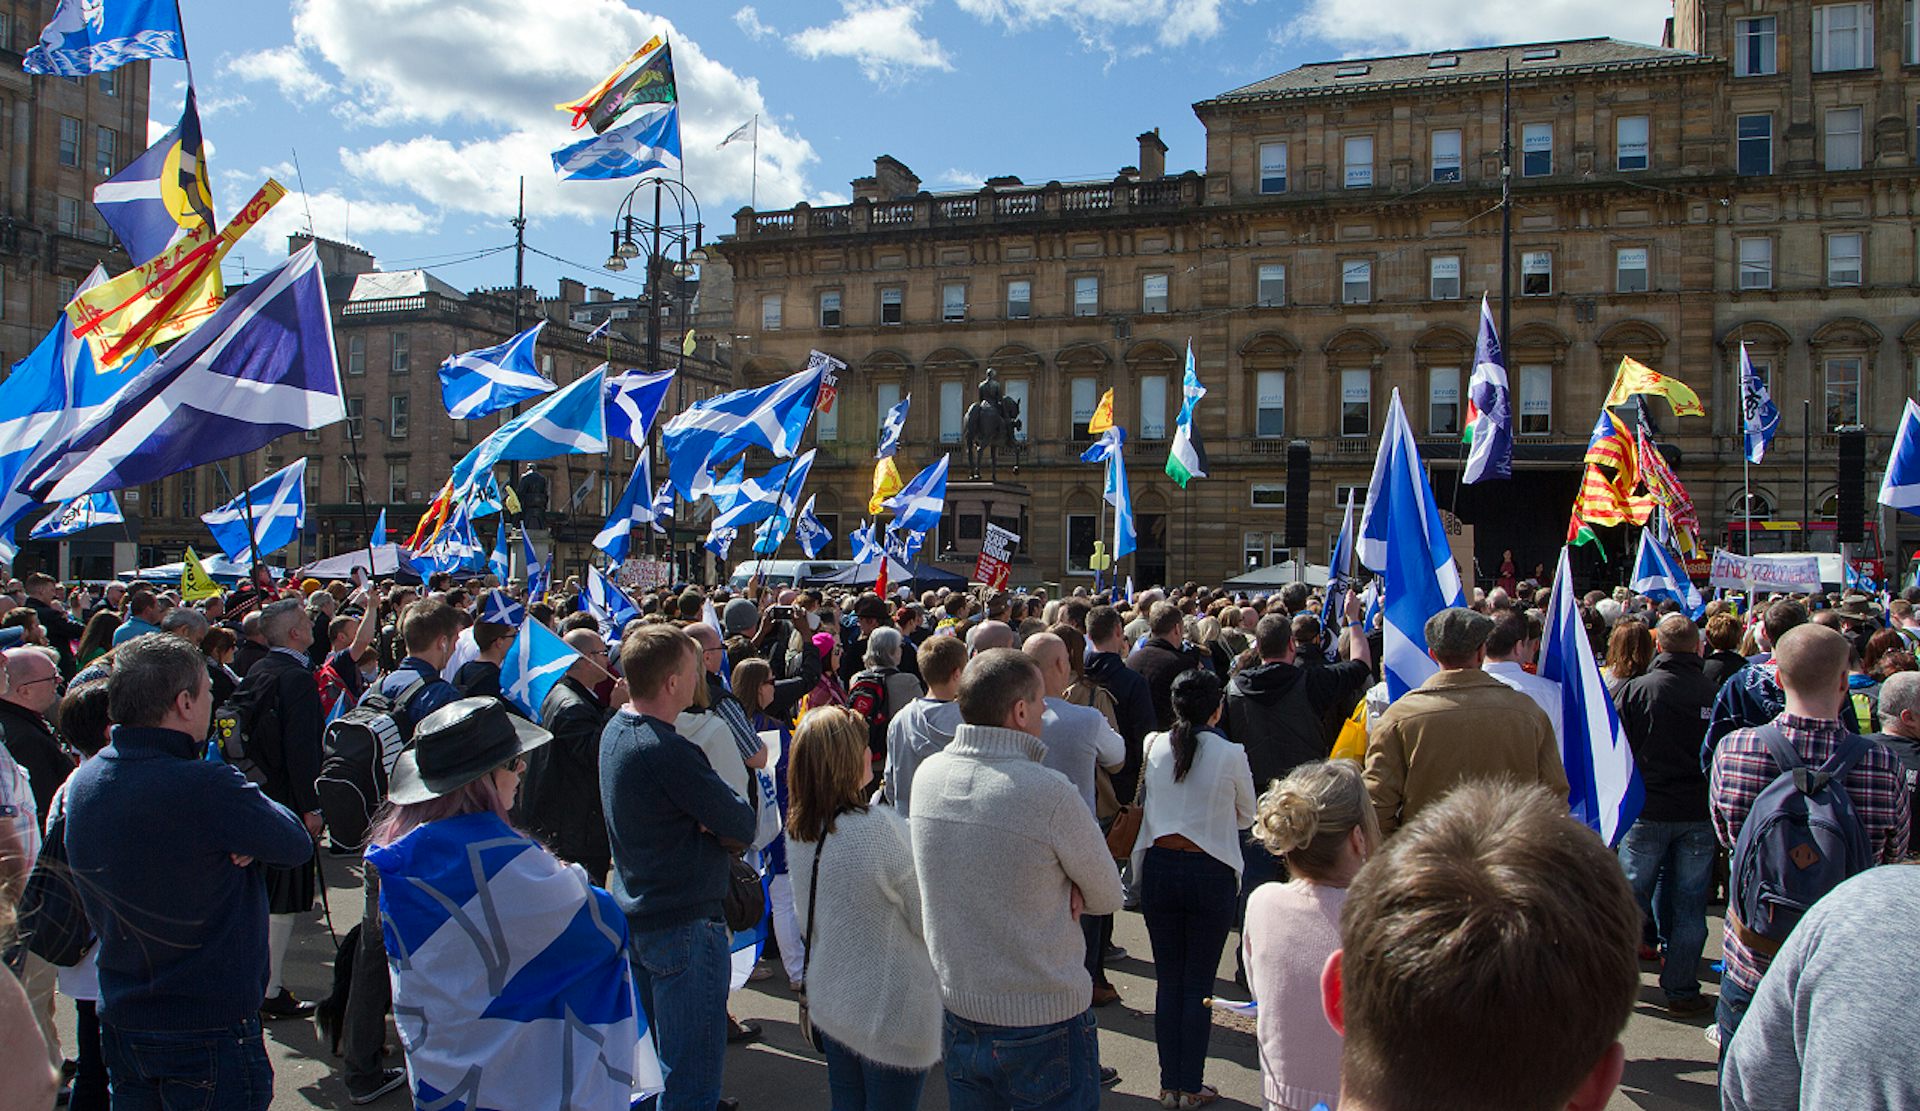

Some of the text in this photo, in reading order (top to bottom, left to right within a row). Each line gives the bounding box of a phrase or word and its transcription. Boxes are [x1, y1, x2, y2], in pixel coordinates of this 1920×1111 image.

[1525, 134, 1551, 142] arvato
[1346, 169, 1371, 177] arvato
[1619, 253, 1645, 261] arvato
